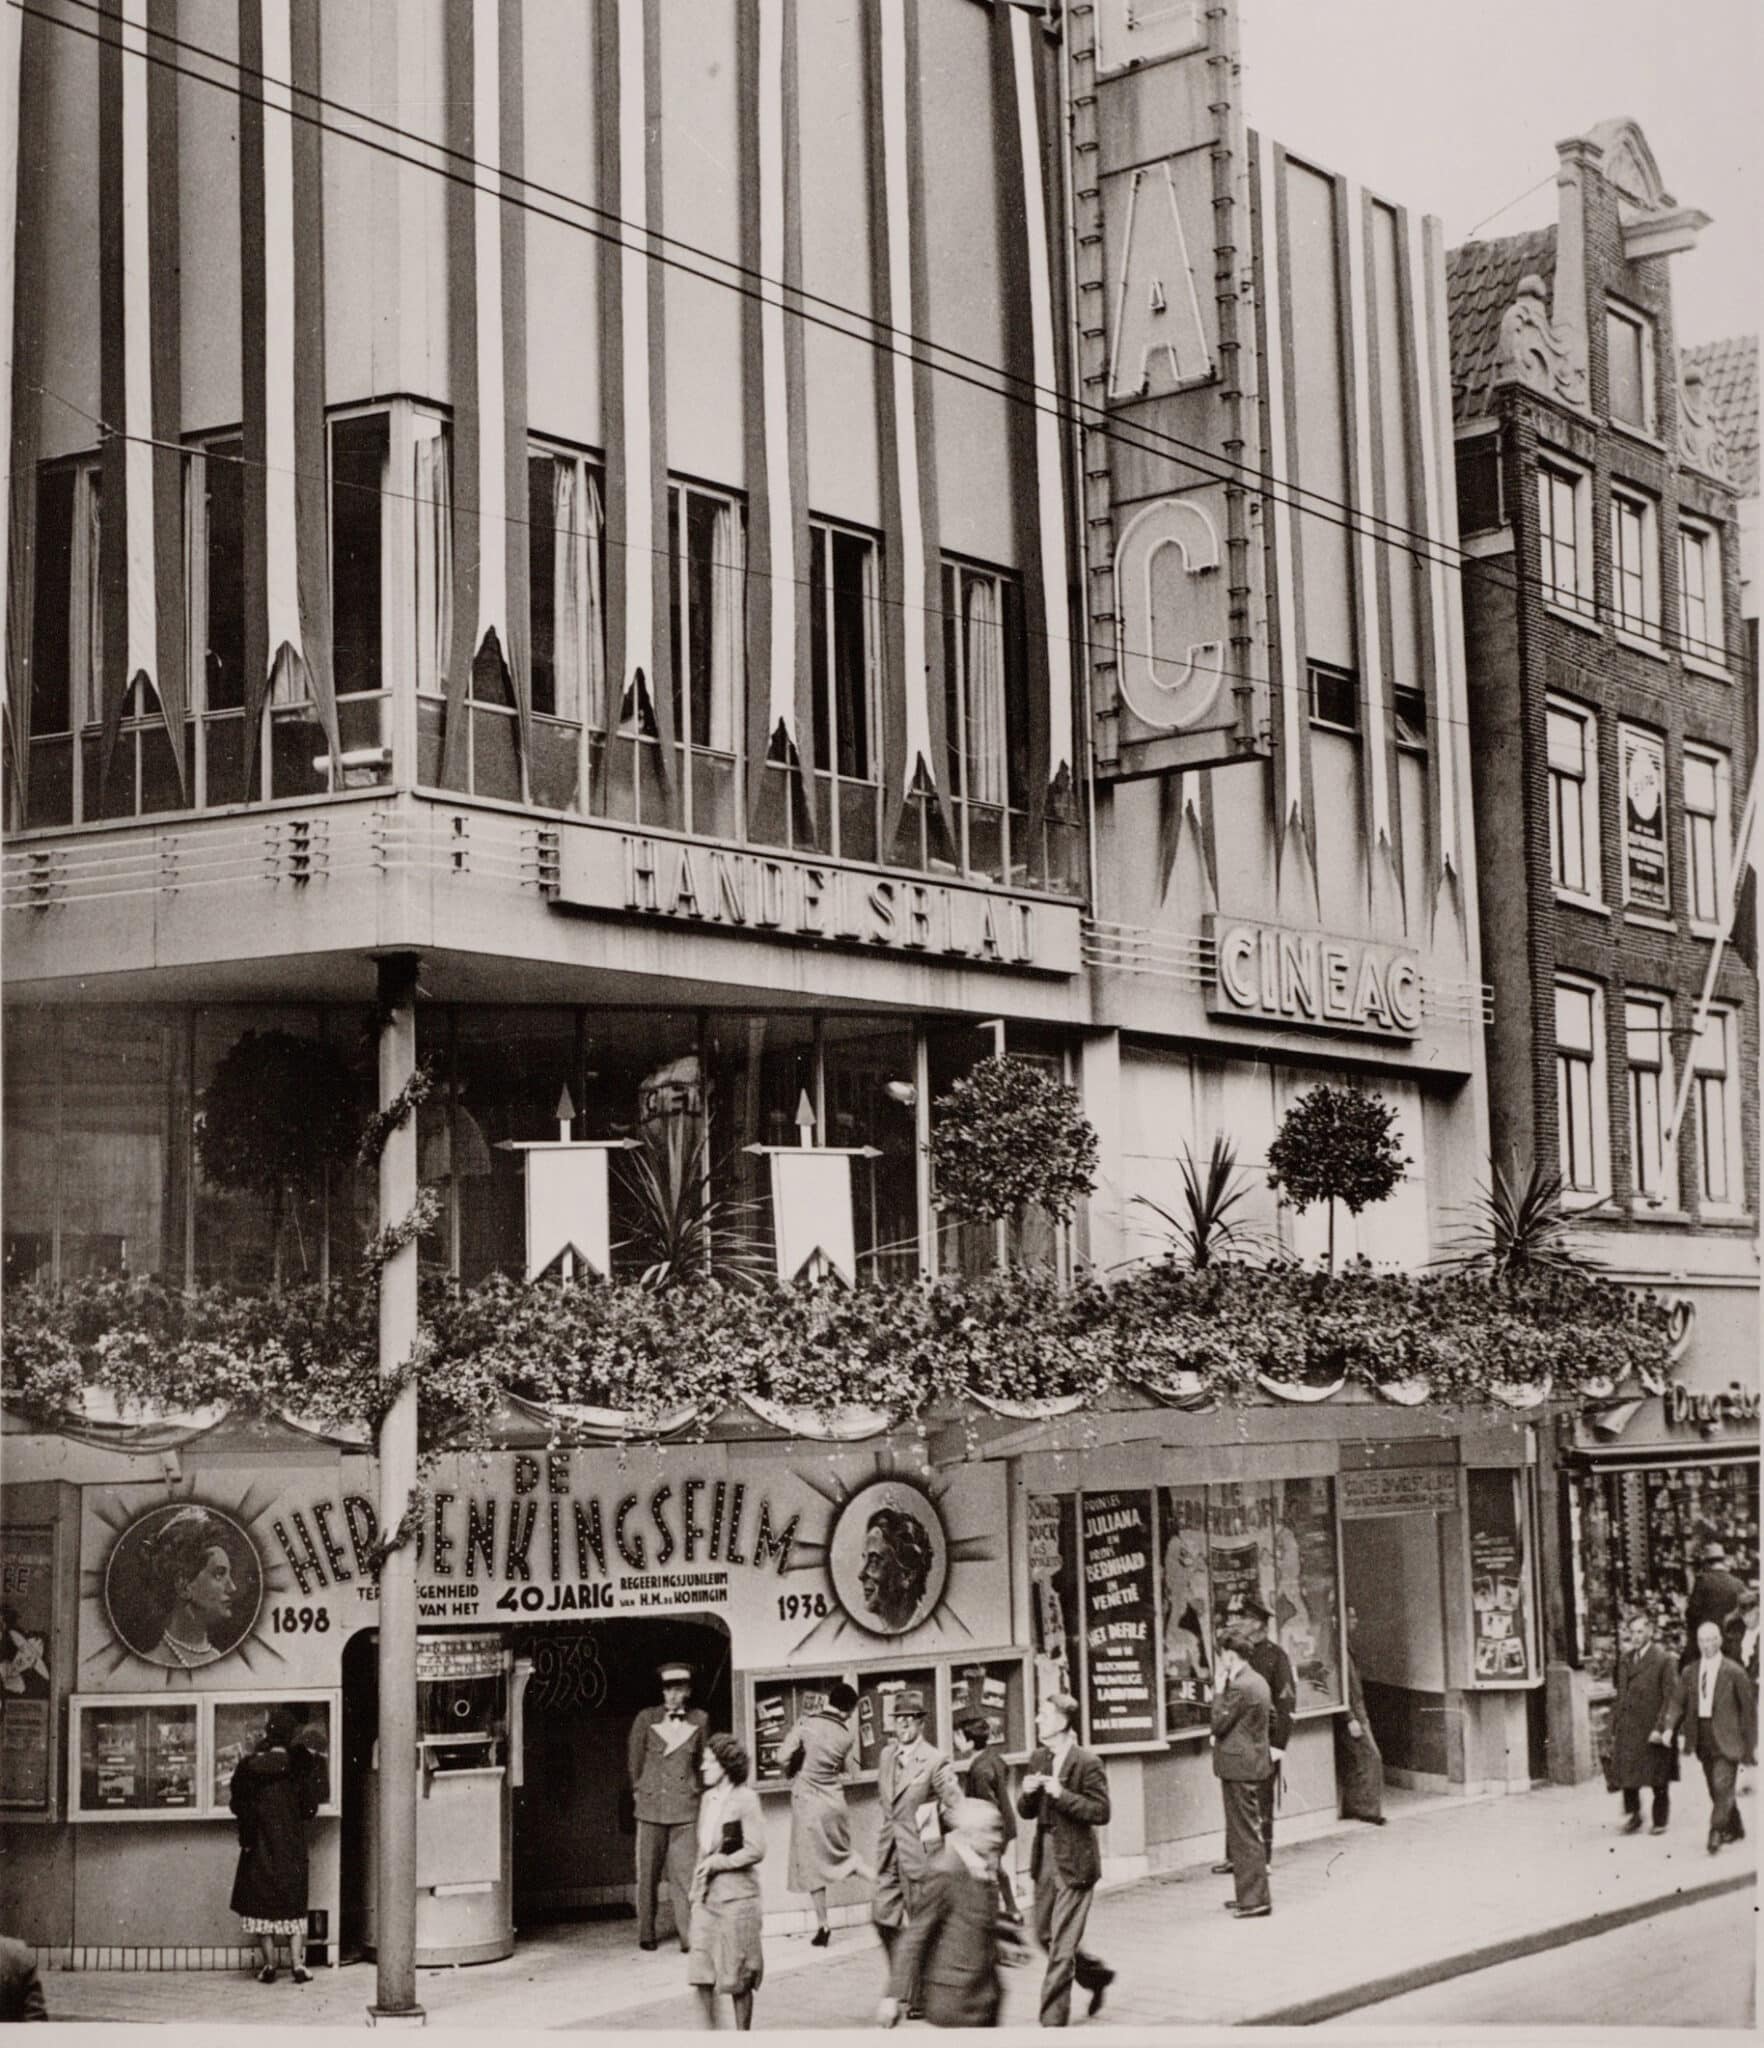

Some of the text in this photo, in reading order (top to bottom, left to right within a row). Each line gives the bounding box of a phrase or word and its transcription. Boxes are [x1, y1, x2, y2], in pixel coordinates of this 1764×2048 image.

[619, 835, 1036, 965] HANDELSBLAD
[1219, 924, 1423, 1031] CINEAC
[513, 1452, 570, 1495] DE
[273, 1478, 800, 1596] HERENKINGSFILM
[1085, 1508, 1142, 1538] JULIANA
[620, 1571, 728, 1591] REGEERINGSJUBILEUM
[1085, 1551, 1146, 1582] BERNHARD
[419, 1602, 479, 1617] VAN HET
[496, 1582, 614, 1613] 40 JARIG
[674, 1588, 728, 1604] KONINGIN
[776, 1593, 828, 1621] 1938
[271, 1606, 331, 1634] 1898
